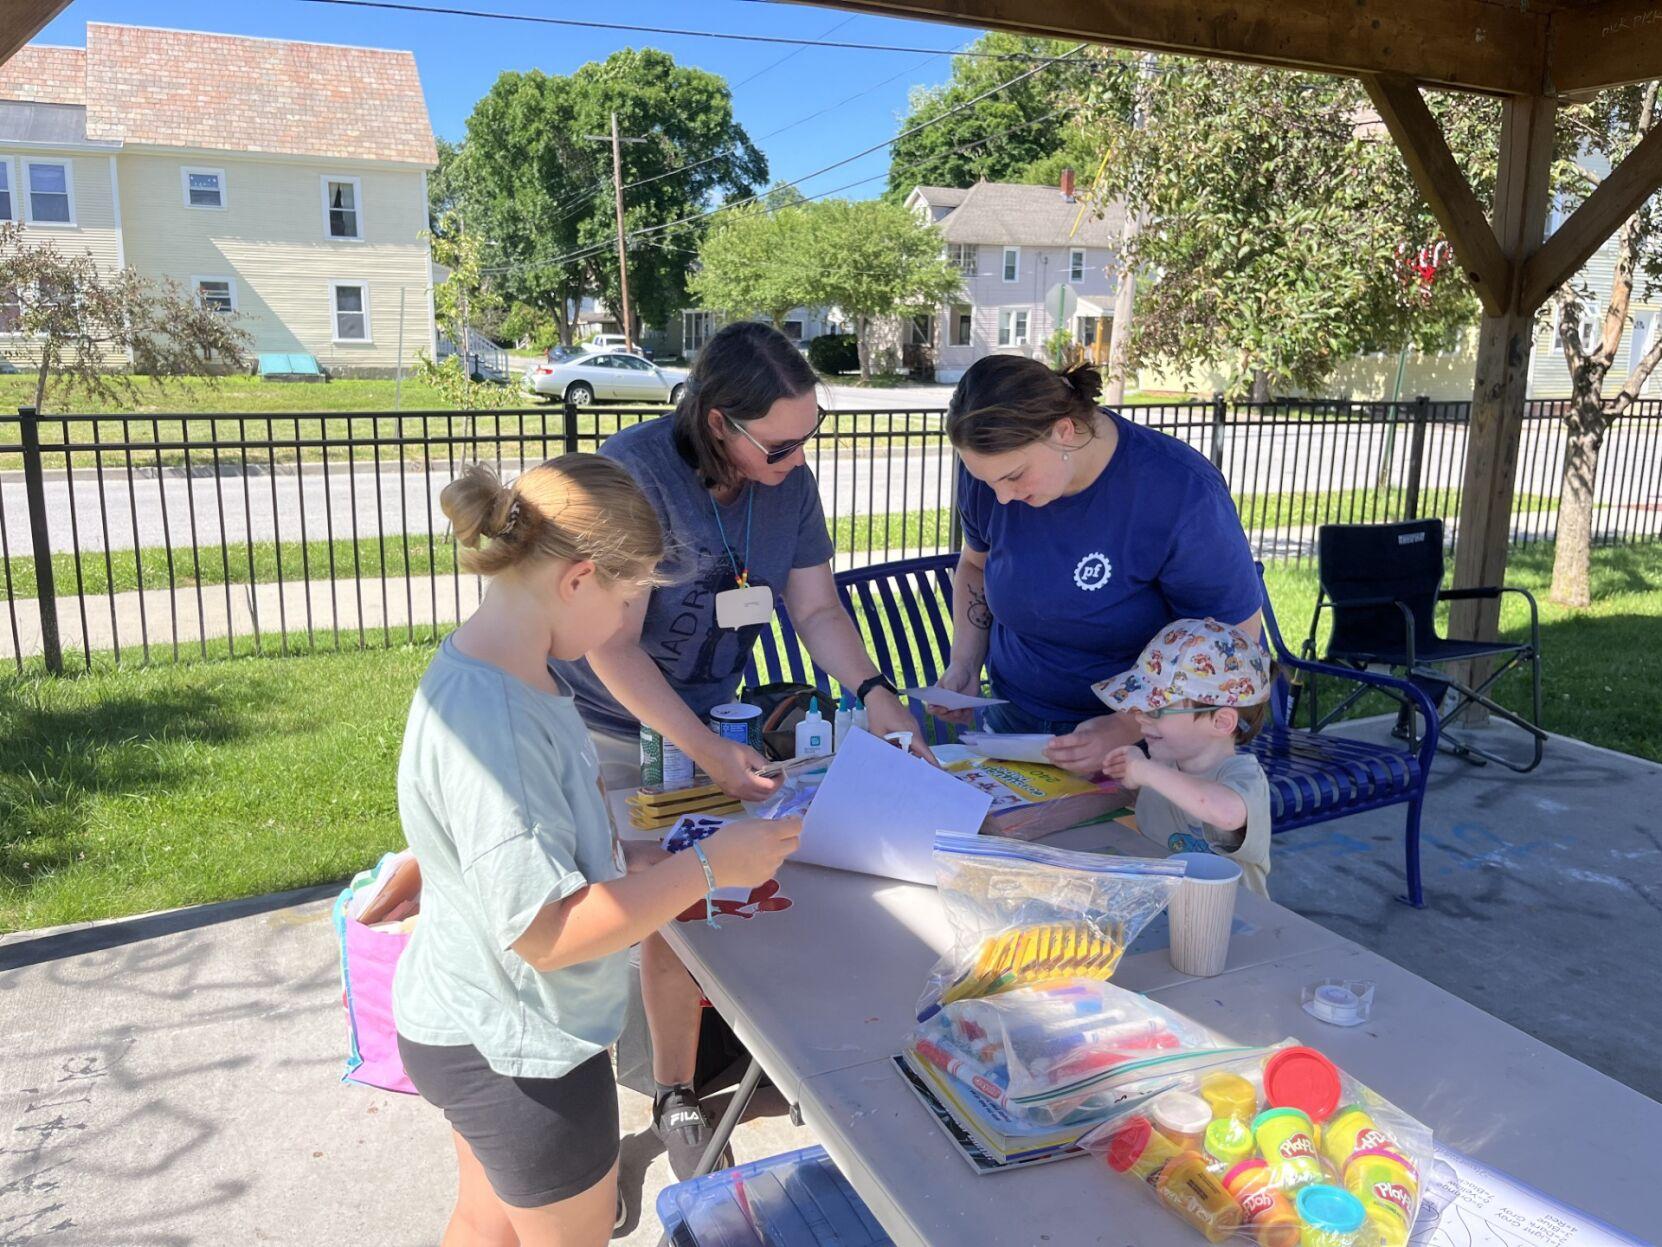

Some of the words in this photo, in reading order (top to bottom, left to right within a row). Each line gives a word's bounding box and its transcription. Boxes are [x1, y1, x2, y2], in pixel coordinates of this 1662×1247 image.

[1081, 564, 1102, 580] pf
[670, 1111, 699, 1126] FILA
[1494, 1212, 1521, 1227] Gray
[1499, 1207, 1526, 1222] Gray
[1536, 1217, 1574, 1237] 3=Blue
[1544, 1214, 1578, 1232] 4=Red
